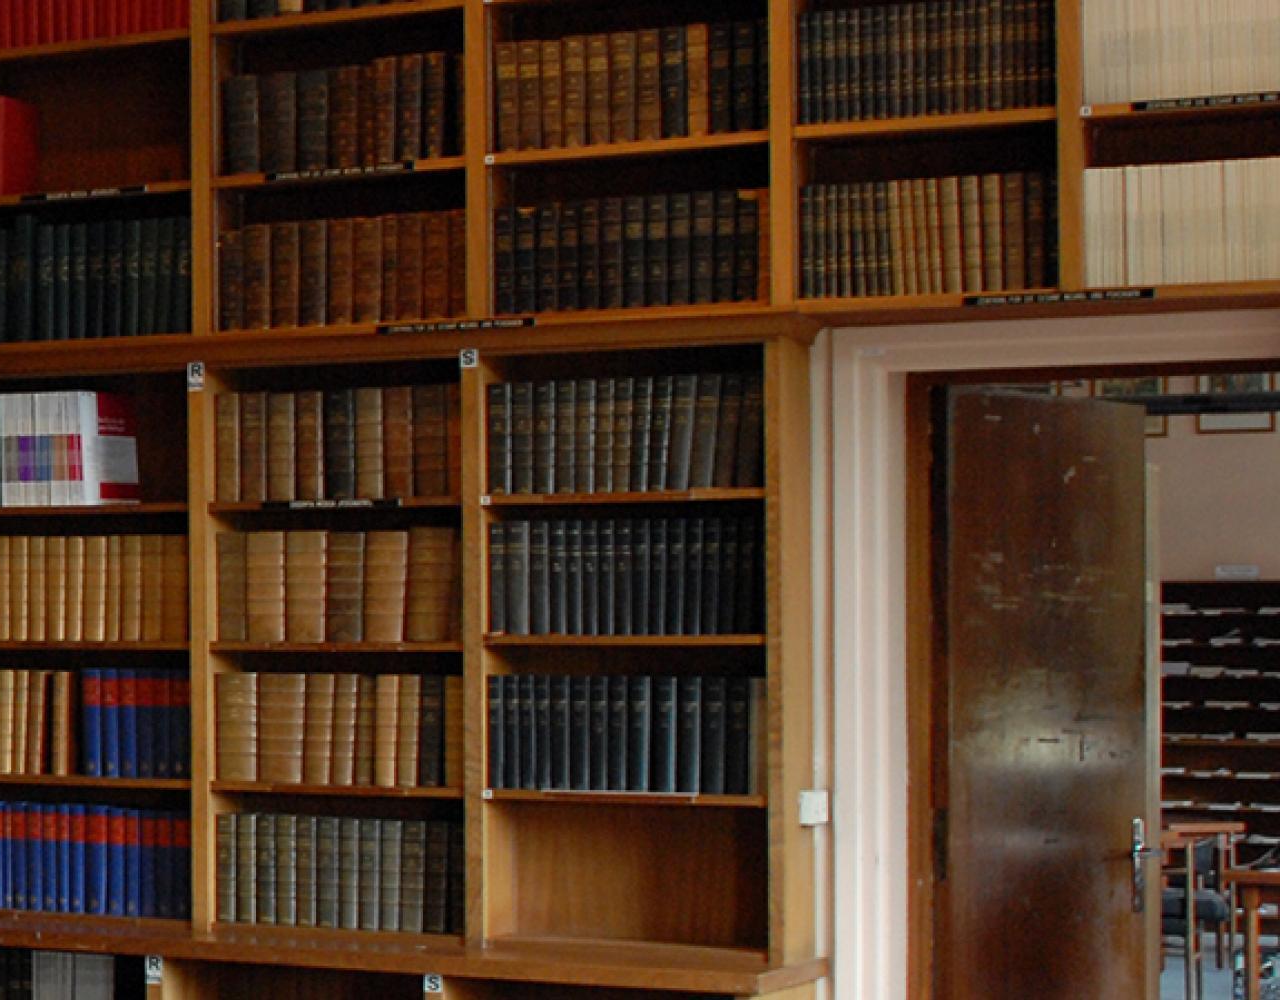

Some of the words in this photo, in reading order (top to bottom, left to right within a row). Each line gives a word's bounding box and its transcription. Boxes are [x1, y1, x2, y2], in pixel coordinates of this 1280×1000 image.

[463, 350, 475, 365] S
[190, 364, 203, 377] R
[149, 957, 161, 970] R
[428, 976, 440, 990] S
